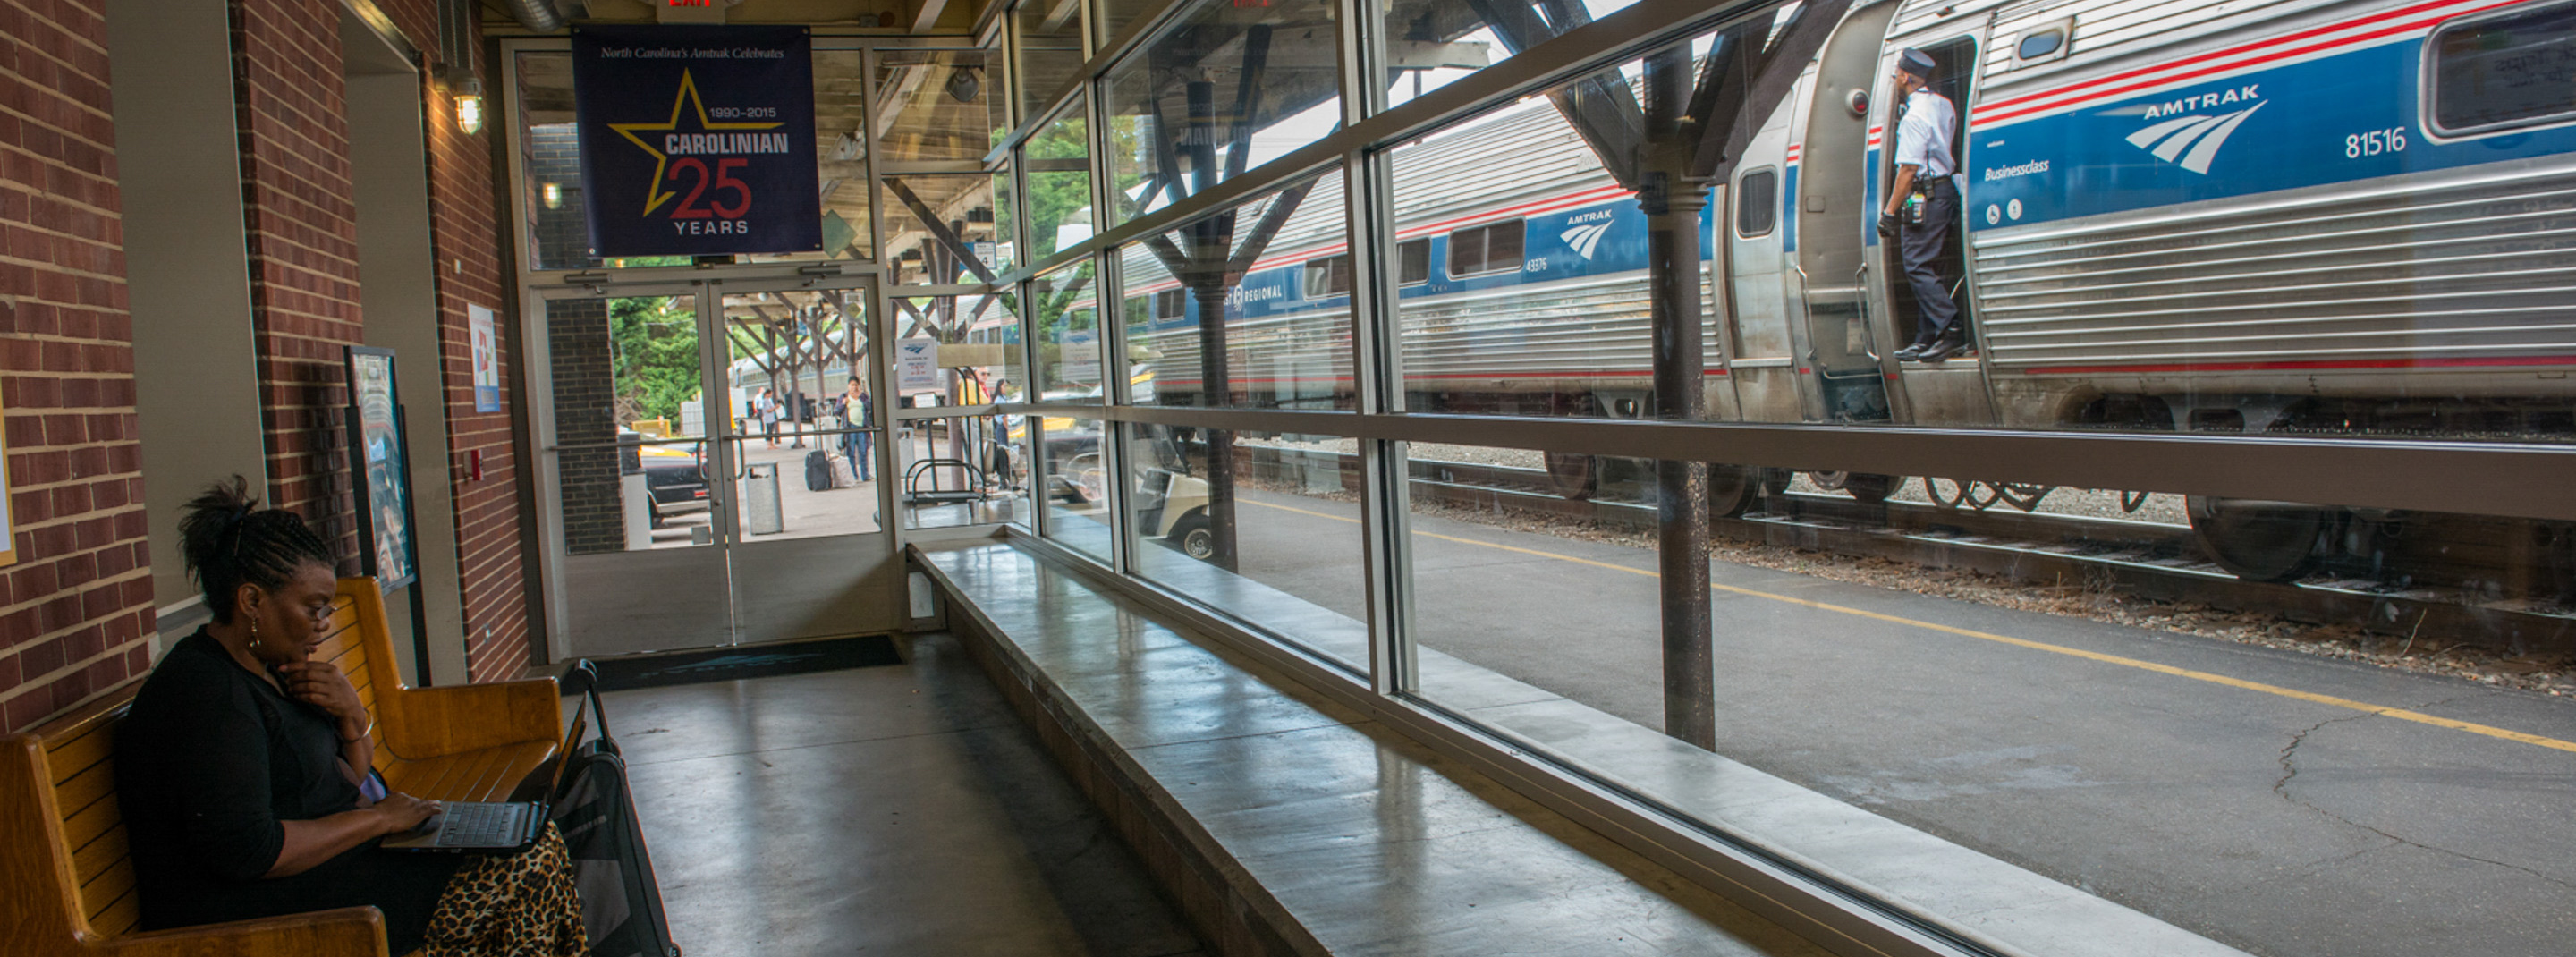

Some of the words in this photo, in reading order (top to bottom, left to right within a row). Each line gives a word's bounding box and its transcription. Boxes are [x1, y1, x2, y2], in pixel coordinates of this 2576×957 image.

[601, 47, 632, 58] North
[634, 47, 688, 59] Carolina's
[691, 47, 730, 58] Amtrak
[732, 47, 784, 59] Celebrates
[2143, 83, 2259, 120] AMTRAK
[709, 107, 776, 118] 1990-2015
[665, 132, 789, 155] CAROLINIAN
[2345, 126, 2406, 159] 81516
[1984, 159, 2050, 182] Businessclass
[668, 157, 752, 220] 25
[1567, 208, 1613, 225] AMTRAK
[674, 220, 750, 235] YEARS
[1244, 284, 1283, 302] REGIONAL
